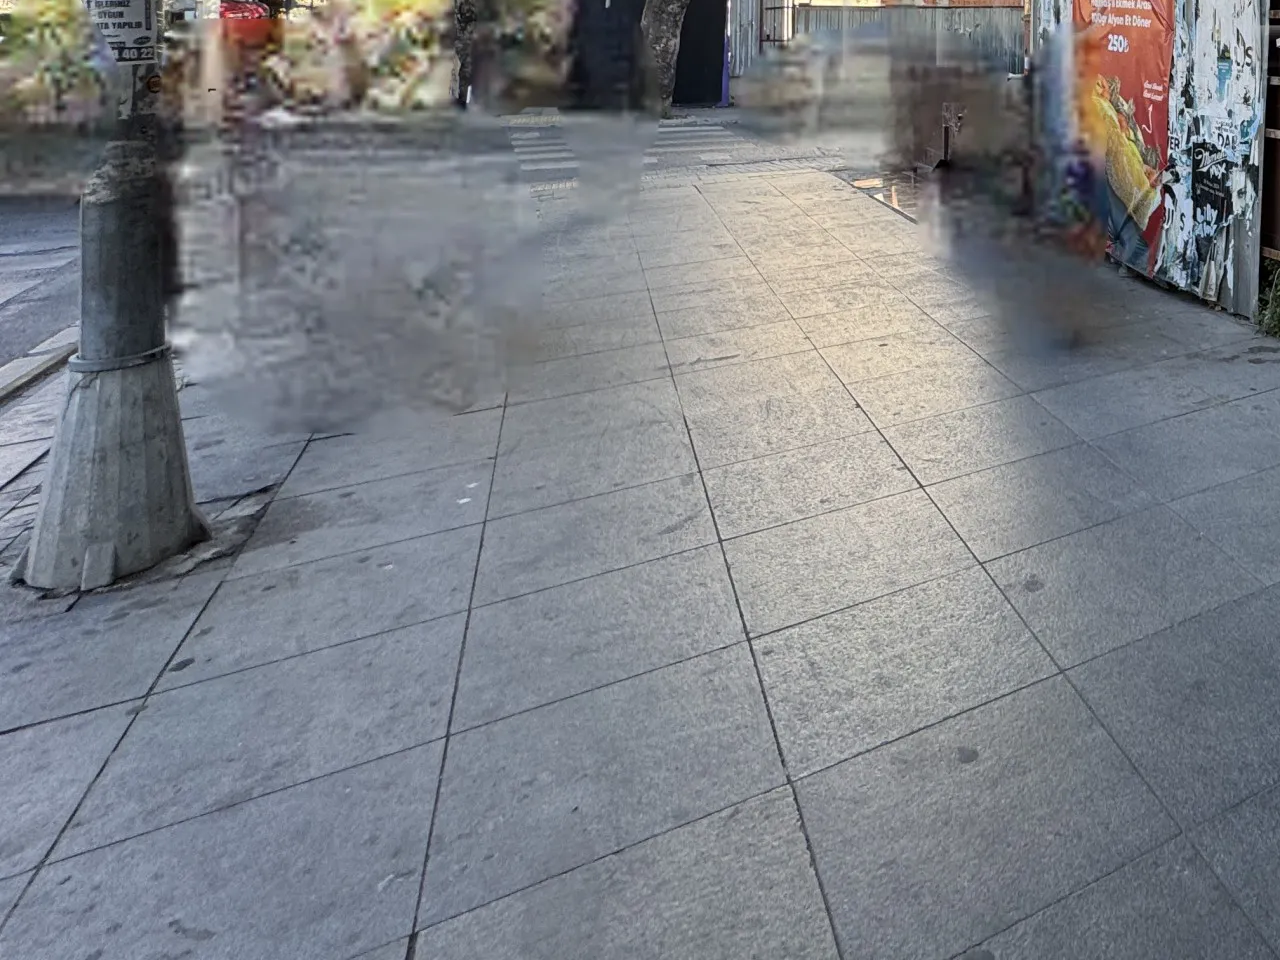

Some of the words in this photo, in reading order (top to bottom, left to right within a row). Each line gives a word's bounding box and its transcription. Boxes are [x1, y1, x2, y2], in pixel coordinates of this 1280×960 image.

[1125, 14, 1133, 26] Et
[1133, 15, 1152, 28] Döner
[141, 48, 154, 58] 22
